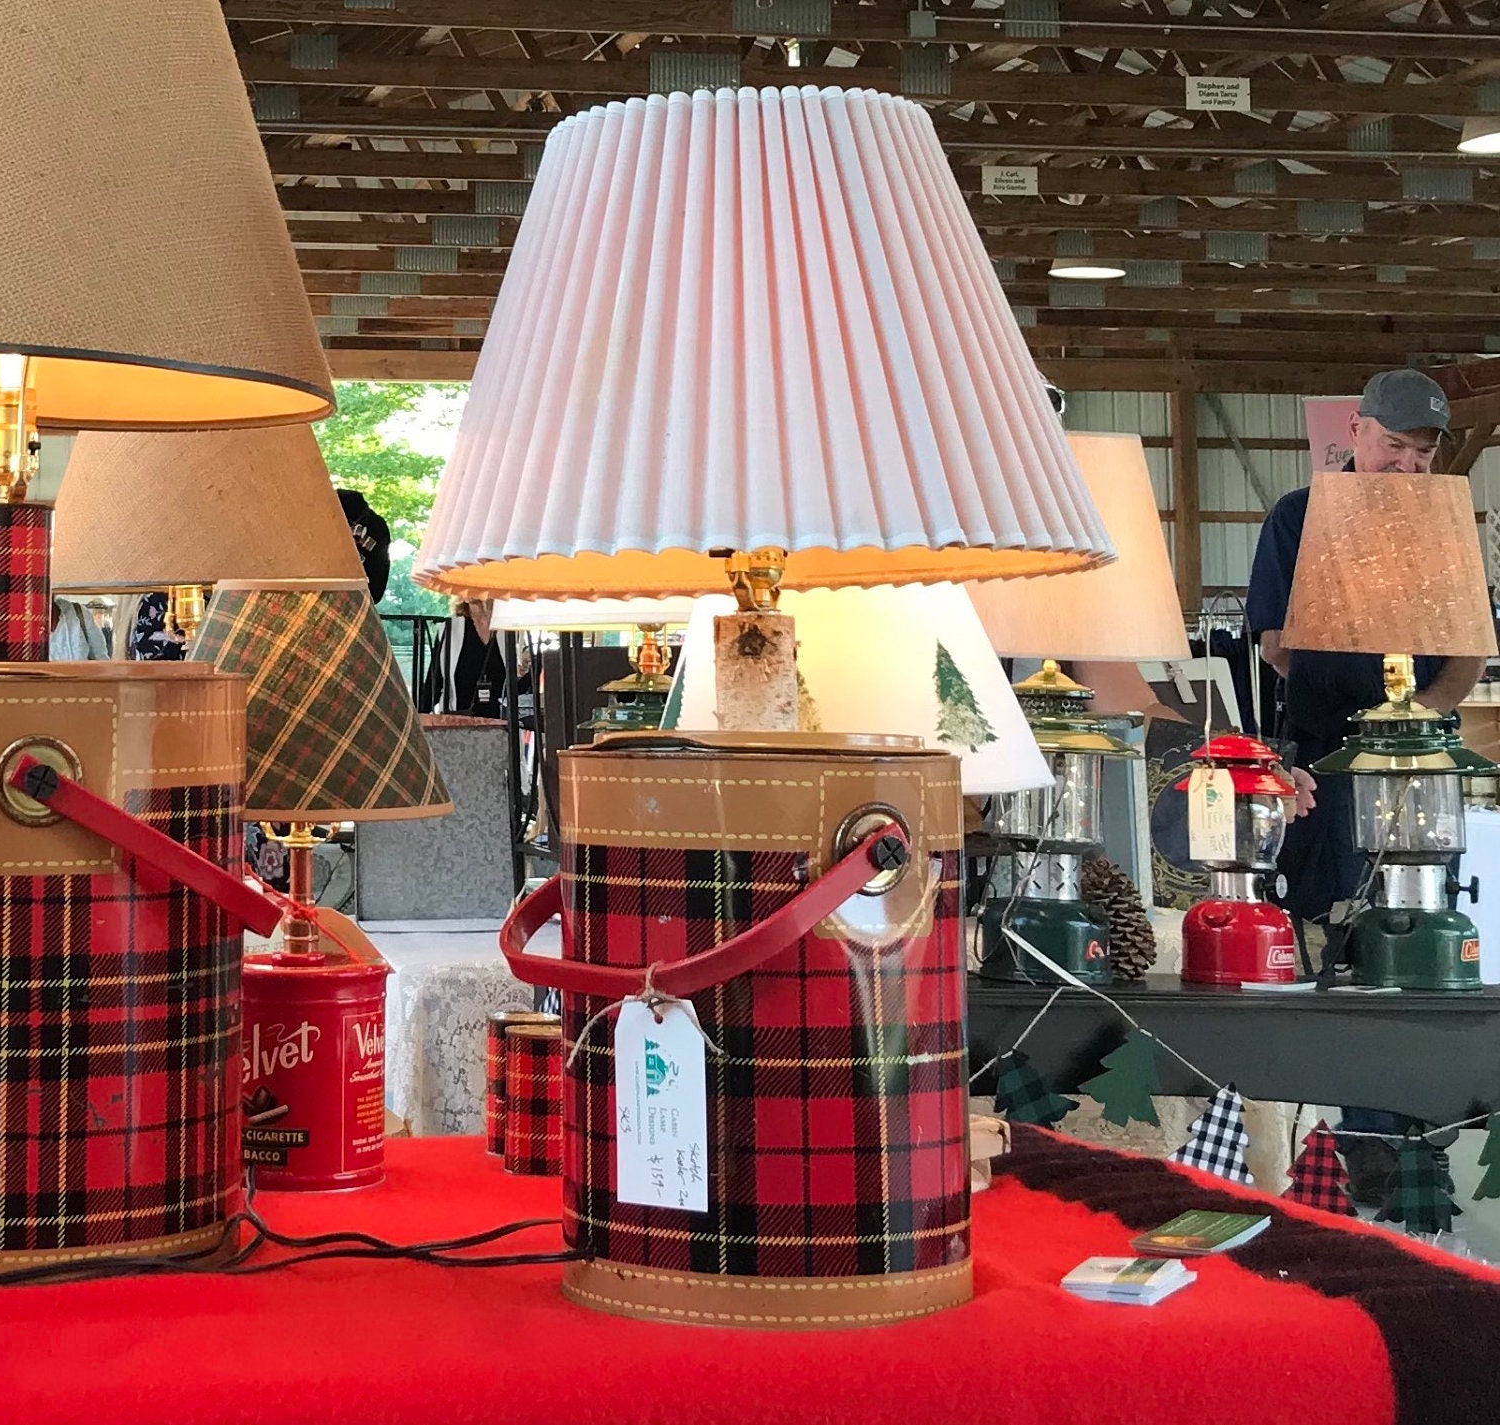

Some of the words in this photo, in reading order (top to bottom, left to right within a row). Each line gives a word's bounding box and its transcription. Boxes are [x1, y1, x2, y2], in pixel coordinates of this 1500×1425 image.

[1196, 82, 1225, 90] Stephen
[1213, 98, 1236, 106] Family
[243, 1149, 280, 1161] BACCO
